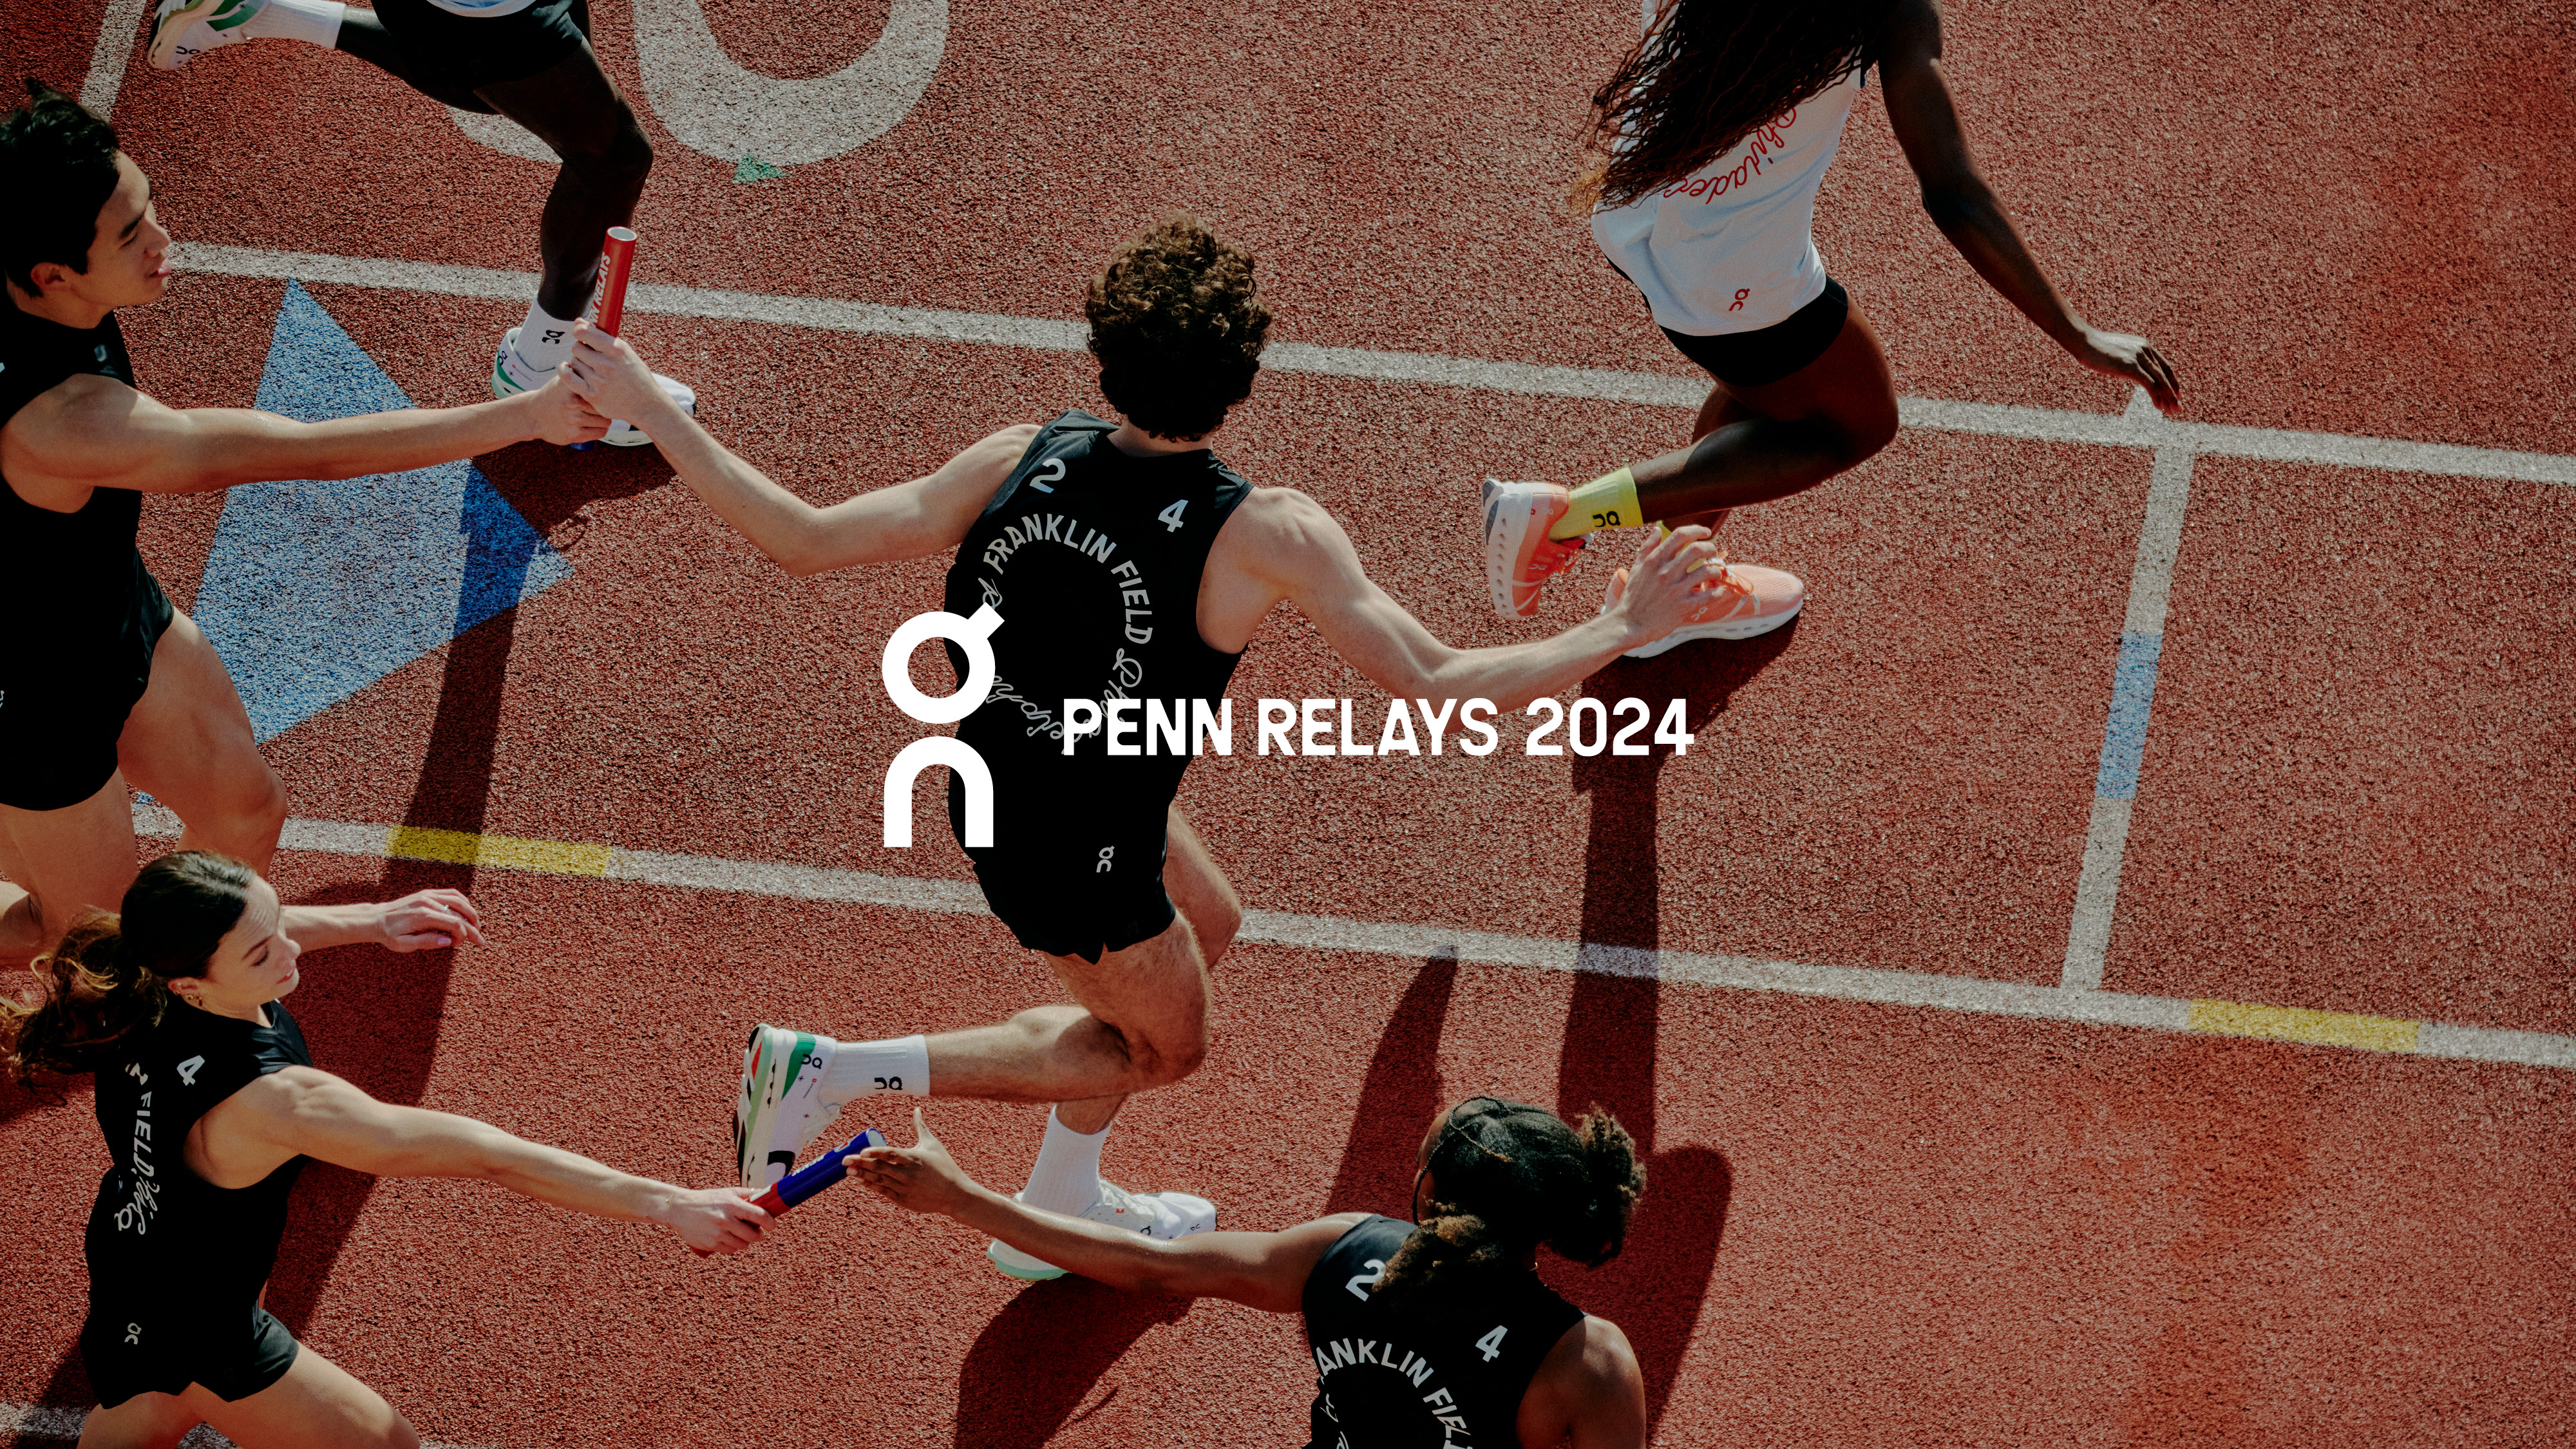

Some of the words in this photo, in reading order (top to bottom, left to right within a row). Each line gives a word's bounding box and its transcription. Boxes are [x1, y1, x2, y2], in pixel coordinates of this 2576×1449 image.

[593, 252, 611, 307] RELAYS
[1030, 458, 1066, 493] 2
[1158, 499, 1189, 533] 4
[983, 513, 1116, 574] FRANKLIN
[1111, 560, 1153, 644] FIELD
[176, 1055, 205, 1086] 4
[133, 1092, 154, 1177] FIELD
[1345, 1258, 1386, 1302] 2
[1316, 1338, 1434, 1388] ANKLIN
[1475, 1325, 1508, 1363] 4
